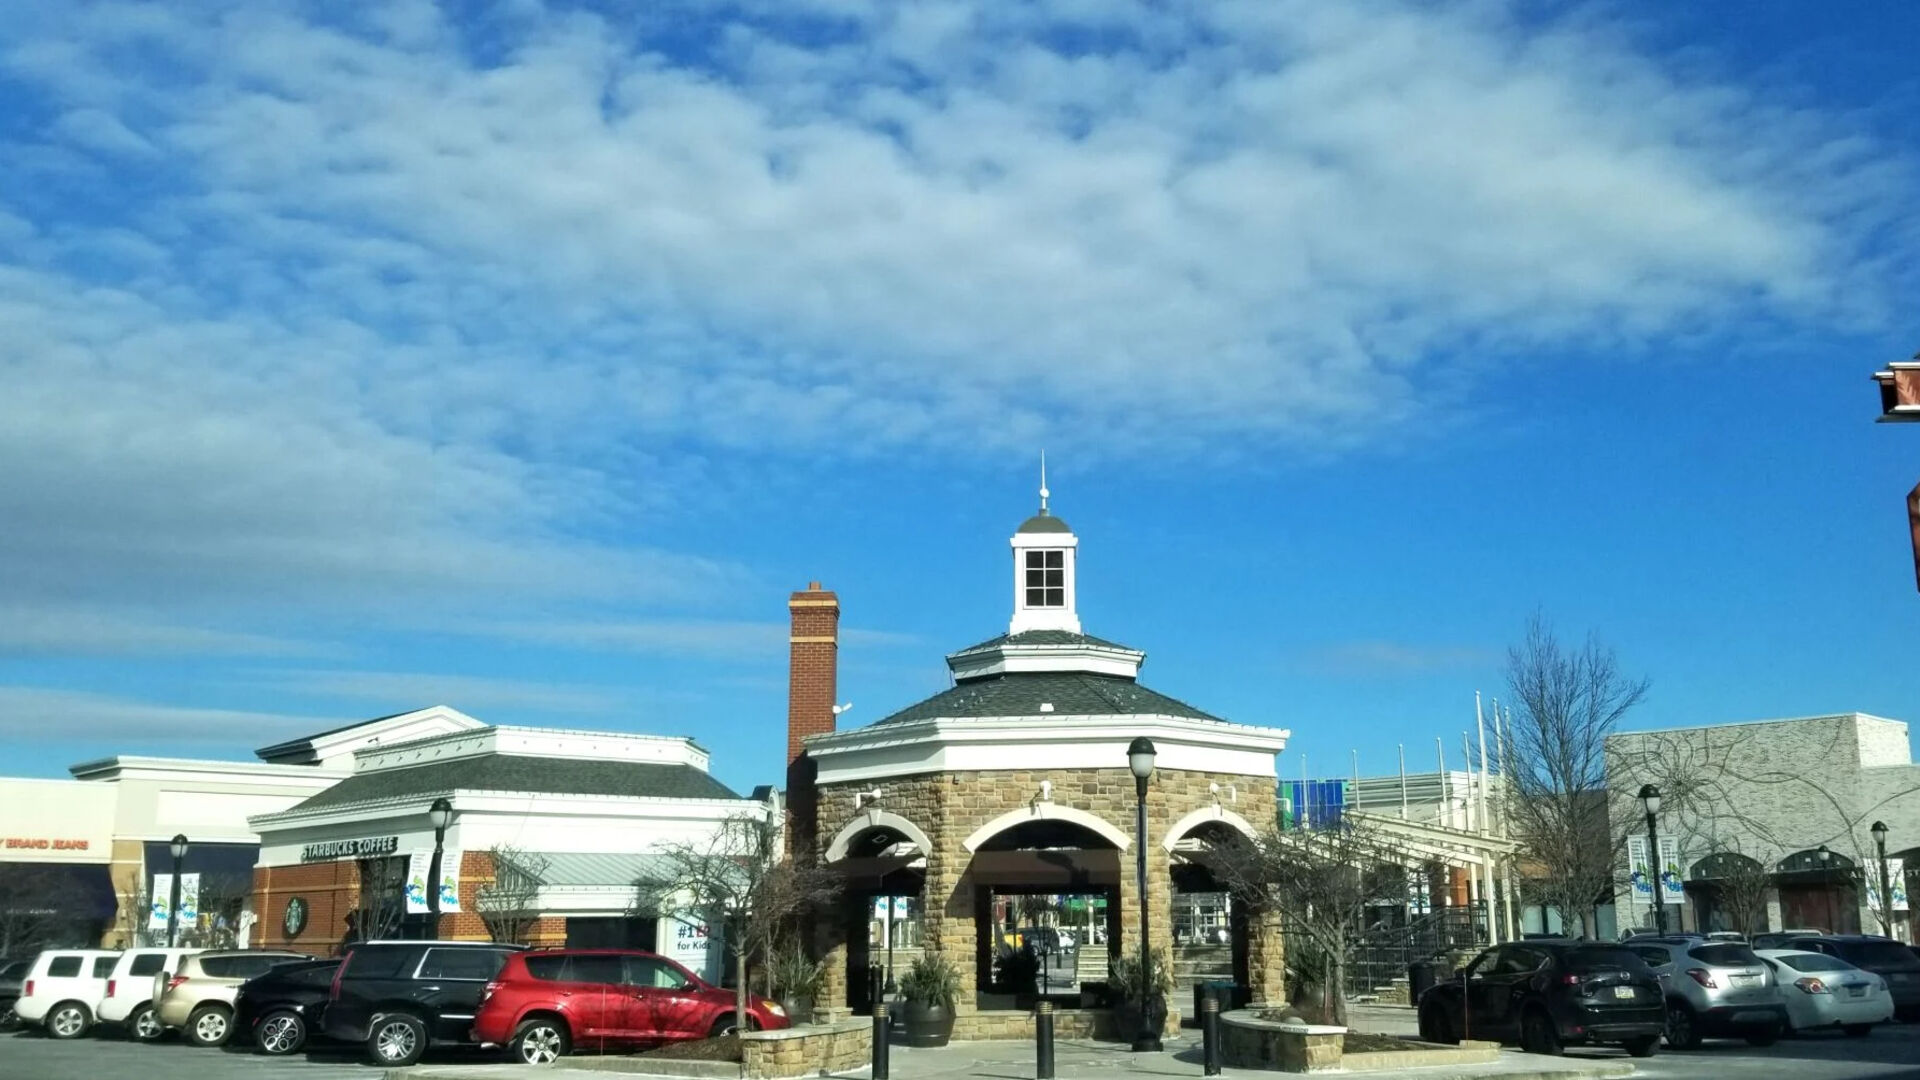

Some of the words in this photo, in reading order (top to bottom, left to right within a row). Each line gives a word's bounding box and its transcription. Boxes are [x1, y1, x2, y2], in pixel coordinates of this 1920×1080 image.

[6, 838, 48, 849] BRAND
[51, 839, 89, 850] JEANS
[302, 840, 354, 858] STARBUCKS
[357, 836, 395, 854] COFFEE
[678, 924, 694, 938] #1
[677, 941, 690, 950] for
[692, 941, 712, 950] Kids
